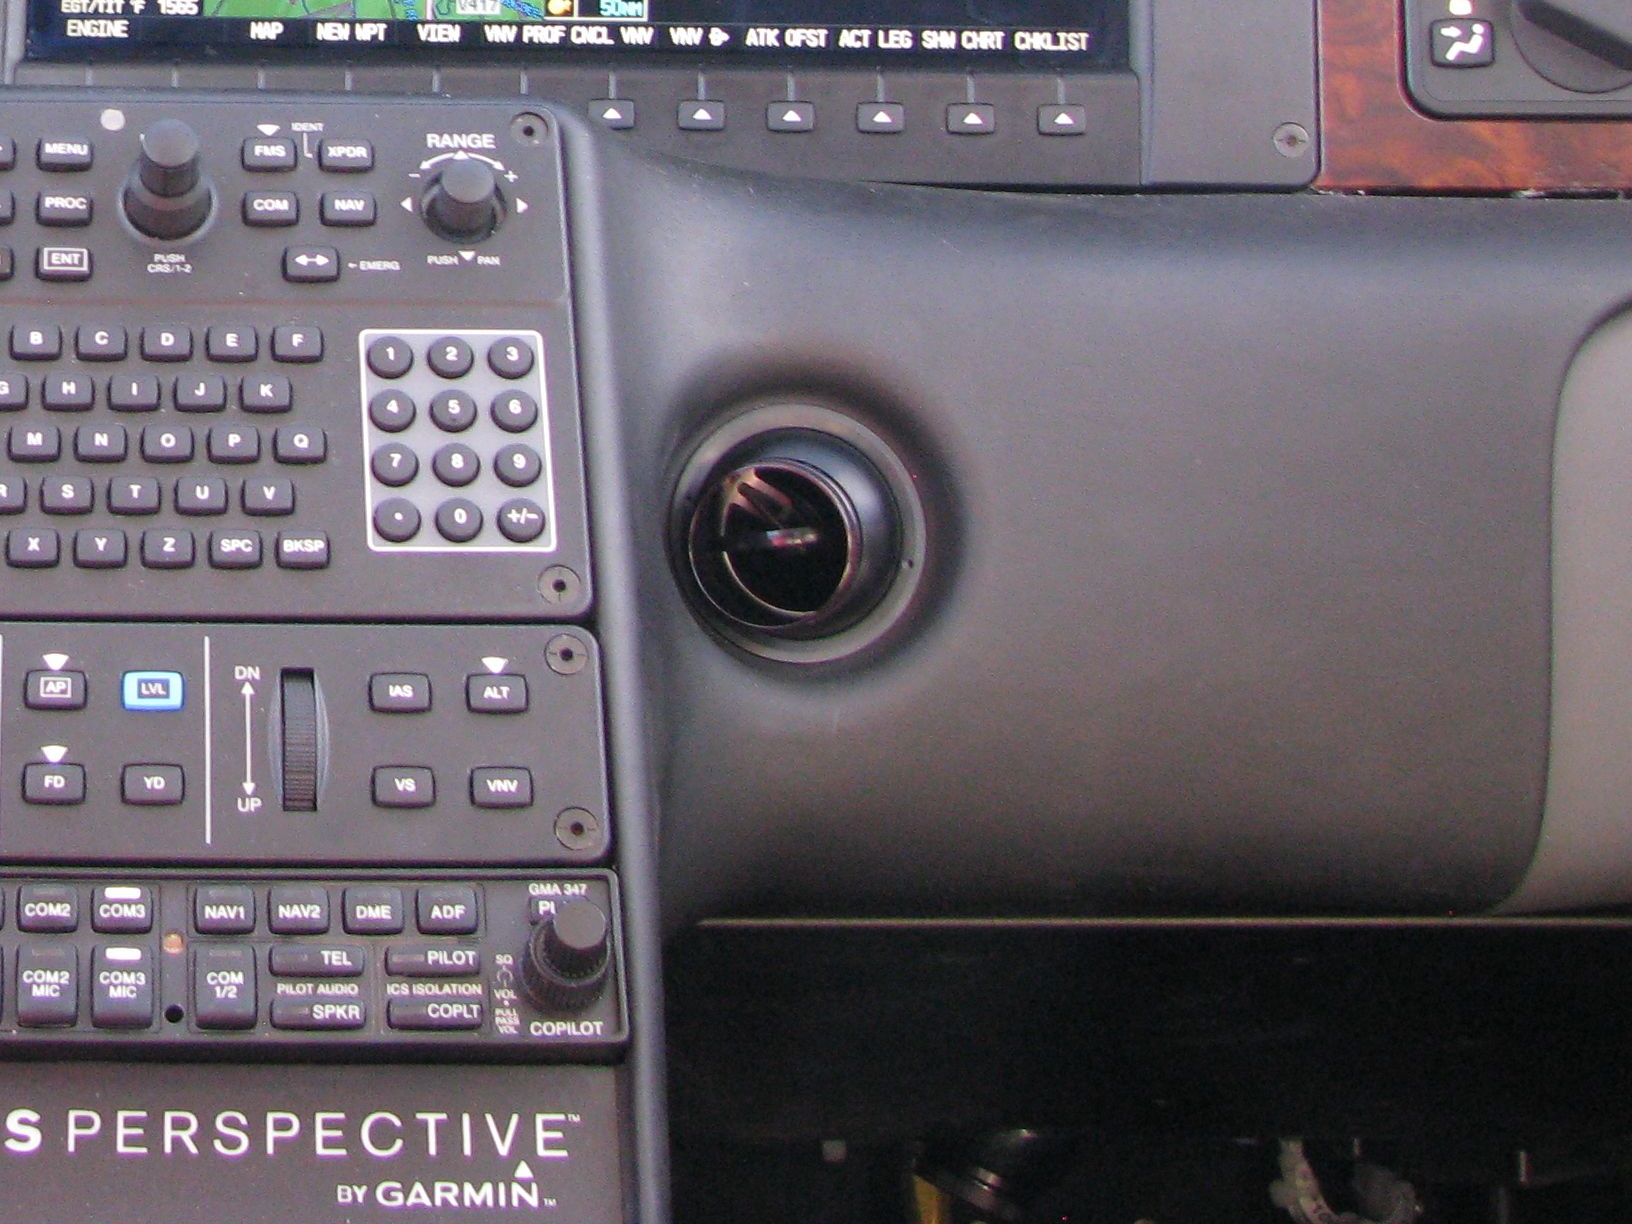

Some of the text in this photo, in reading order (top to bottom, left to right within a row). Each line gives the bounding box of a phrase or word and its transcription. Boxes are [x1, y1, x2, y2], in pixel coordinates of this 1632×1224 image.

[67, 22, 128, 37] ENGINE
[250, 24, 282, 38] MAP
[524, 25, 565, 42] PROF
[839, 31, 872, 47] ACT
[878, 31, 912, 48] LEG
[961, 32, 1003, 49] CHRT
[427, 134, 495, 148] RANGE
[45, 143, 87, 154] MENU
[255, 147, 286, 158] FMS
[328, 147, 366, 158] XPDR
[45, 197, 86, 210] PROC
[254, 199, 288, 211] COM
[335, 200, 364, 211] NAV
[52, 252, 81, 265] ENT
[30, 332, 42, 344] B
[161, 333, 174, 345] D
[446, 347, 457, 360] 2
[62, 382, 75, 394] H
[260, 384, 273, 397] K
[448, 400, 460, 413] 5
[451, 454, 463, 468] 8
[129, 486, 140, 497] T
[221, 540, 252, 552] SPC
[284, 540, 324, 552] BKSP
[235, 666, 260, 679] DN
[46, 682, 67, 693] AP
[141, 683, 166, 695] LVL
[389, 685, 413, 697] IAS
[484, 687, 509, 699] ALT
[45, 776, 64, 789] FD
[144, 777, 164, 789] YD
[395, 780, 415, 792] VS
[488, 780, 517, 792] VNV
[238, 798, 261, 812] UP
[25, 904, 70, 916] COM2
[100, 905, 145, 918] COM3
[205, 906, 244, 919] NAV1
[279, 905, 320, 919] NAV2
[357, 906, 391, 919] DME
[431, 906, 465, 919] ADF
[321, 952, 351, 965] TEL
[428, 951, 476, 965] PILOT
[207, 972, 244, 984] COM
[32, 985, 59, 996] MIC
[110, 986, 136, 997] MIC
[277, 984, 358, 995] PILOT AUDIO
[387, 984, 482, 994] ICS ISOLATION
[313, 1005, 360, 1018] SPKR
[428, 1004, 479, 1018] COPLT
[530, 1021, 603, 1036] COPILOT
[337, 1181, 539, 1208] BY GARMIN
